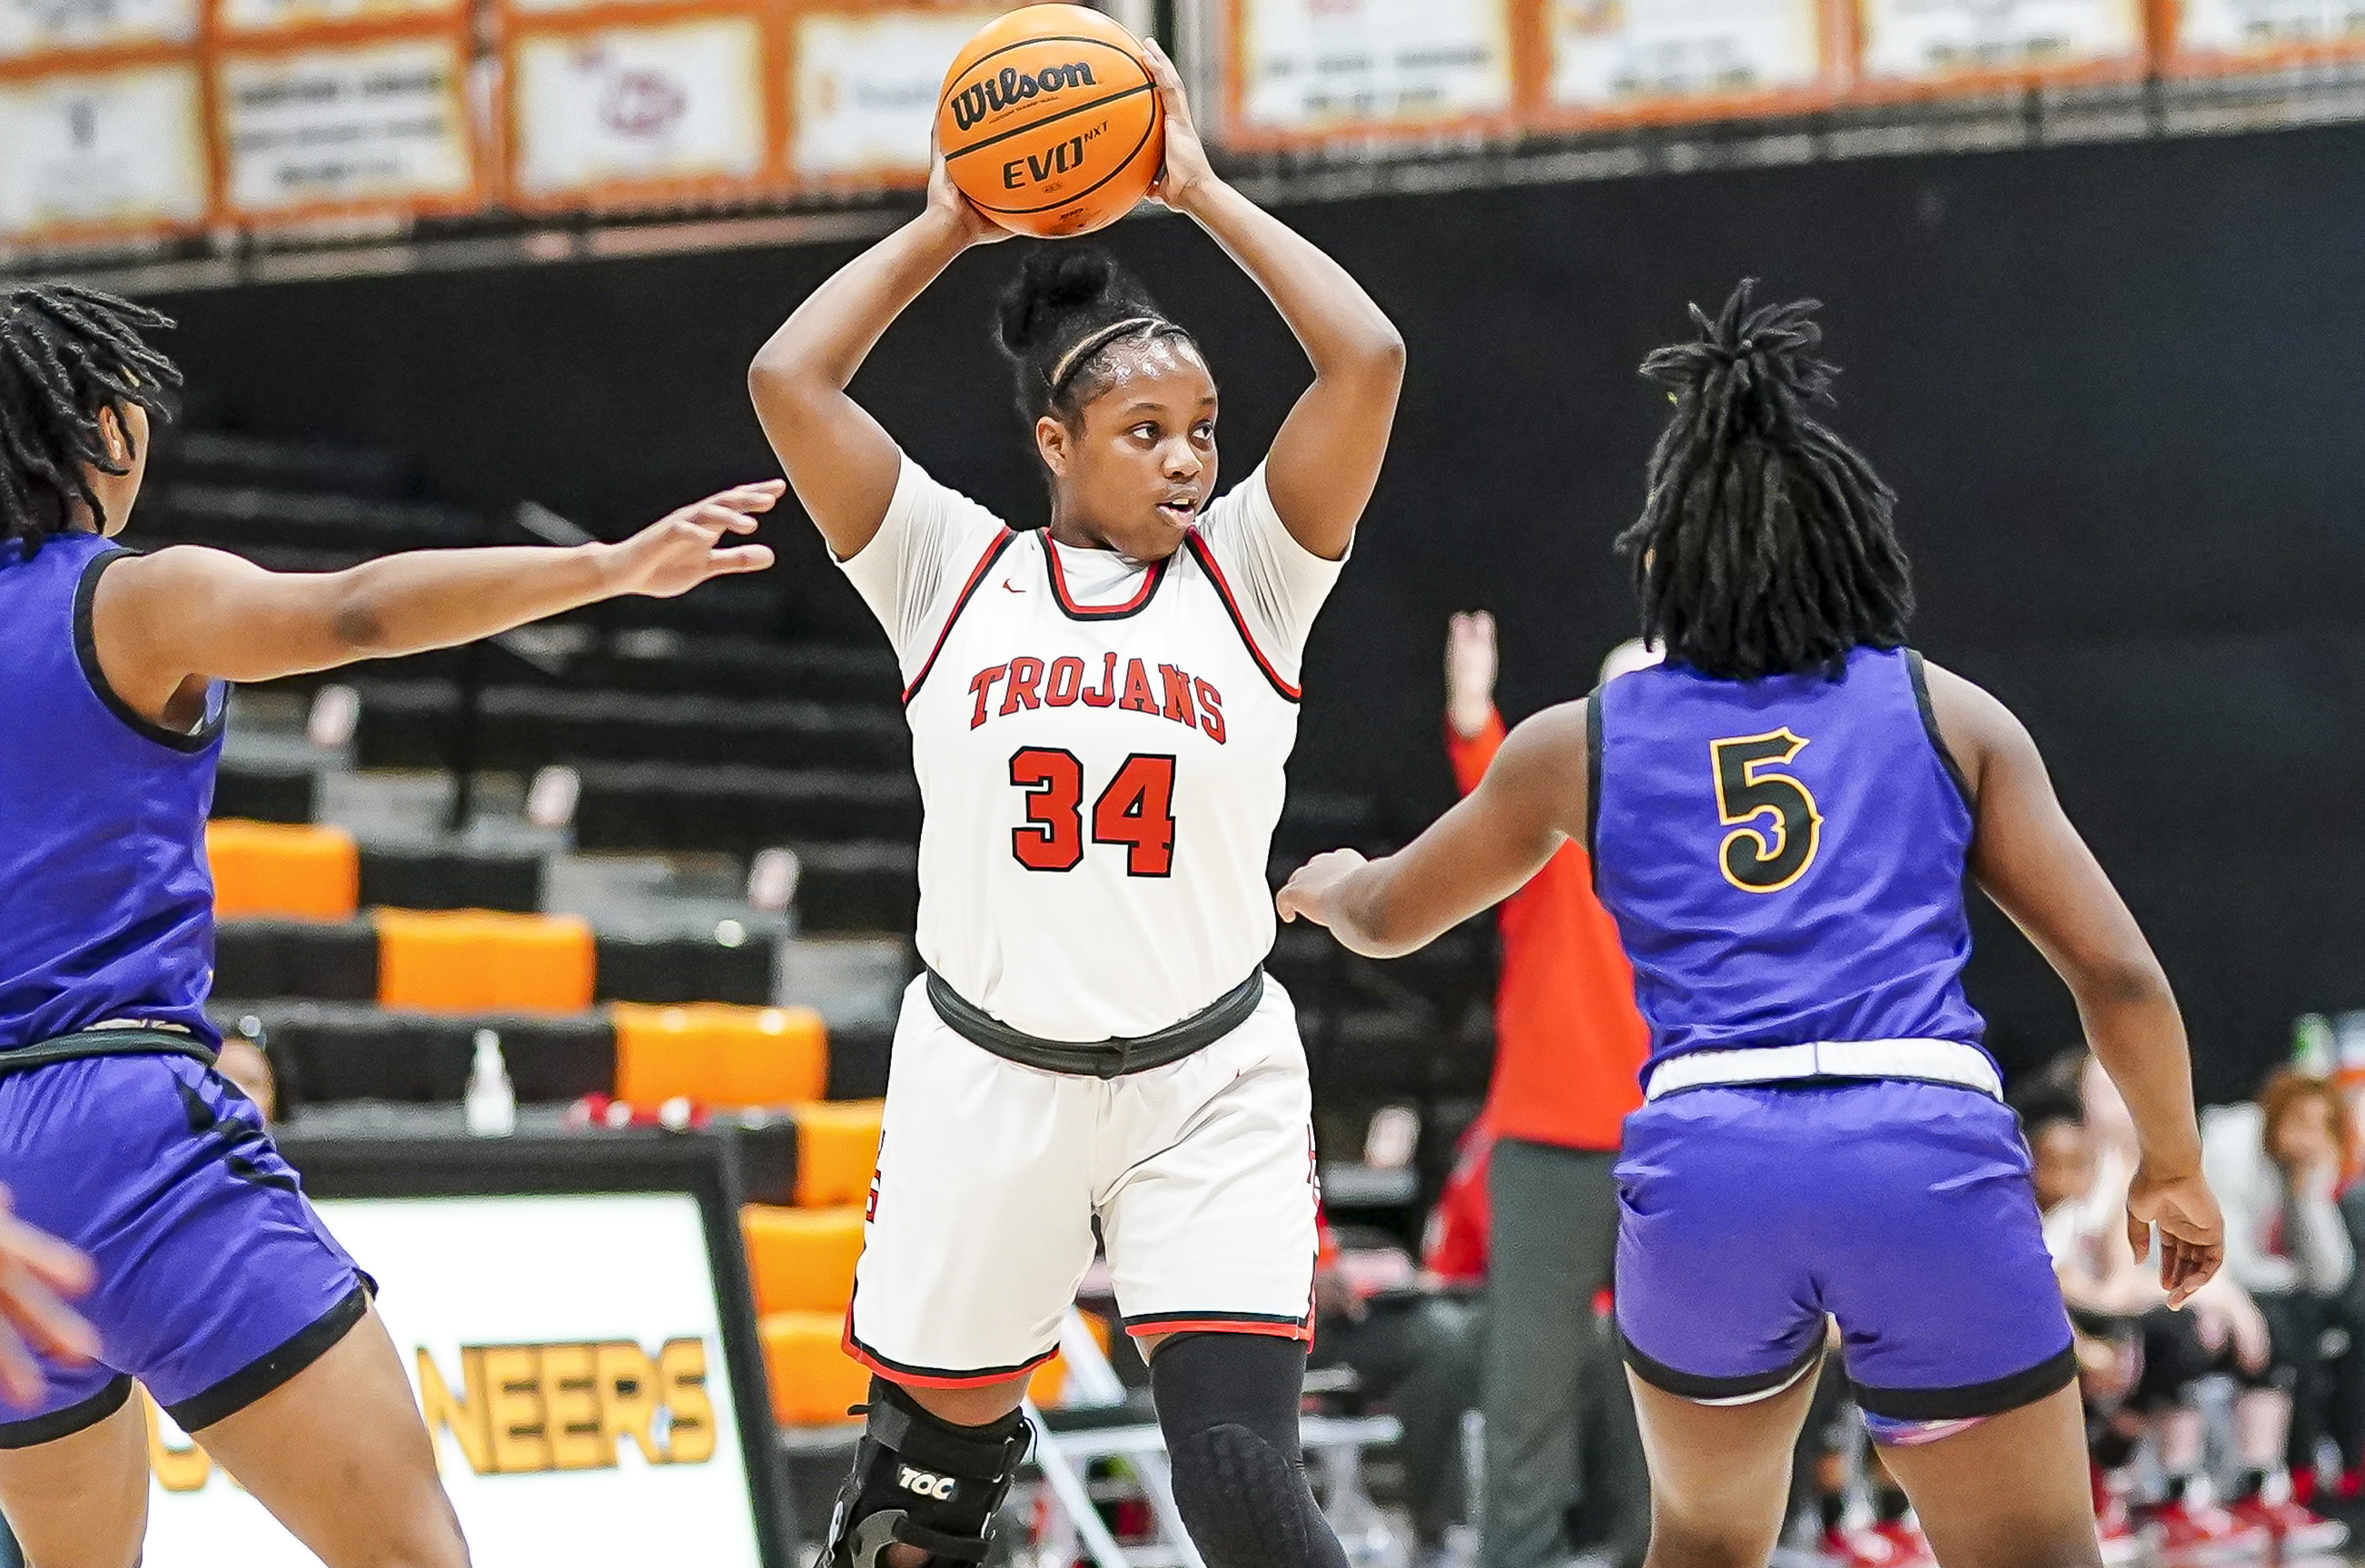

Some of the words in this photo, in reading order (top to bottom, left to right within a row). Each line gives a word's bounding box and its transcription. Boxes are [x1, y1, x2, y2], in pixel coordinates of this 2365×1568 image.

[951, 62, 1096, 132] Wilson
[1003, 136, 1084, 189] EVO
[1084, 121, 1109, 143] NXT
[968, 652, 1226, 745] TROJANS
[1008, 745, 1176, 878] 34
[1709, 725, 1825, 893] 5
[416, 1337, 715, 1476] NEERS
